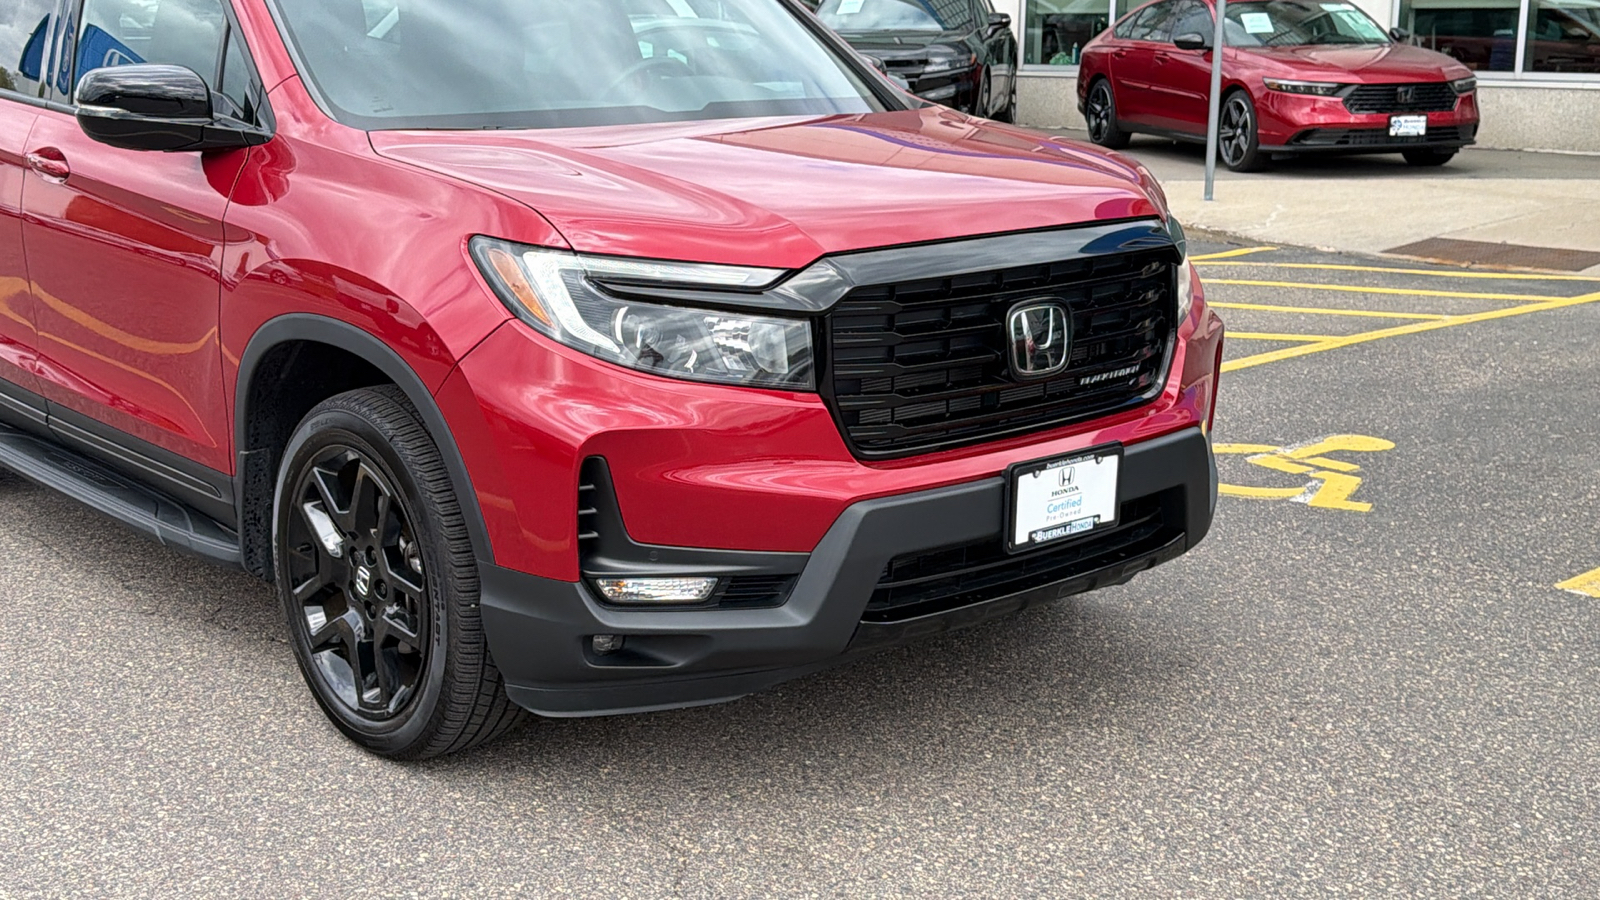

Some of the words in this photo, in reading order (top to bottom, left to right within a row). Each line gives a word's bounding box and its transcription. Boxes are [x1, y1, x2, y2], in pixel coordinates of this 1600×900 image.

[1051, 486, 1079, 497] HONDA
[1047, 495, 1082, 514] Certified
[1046, 507, 1081, 522] Pre-Owned
